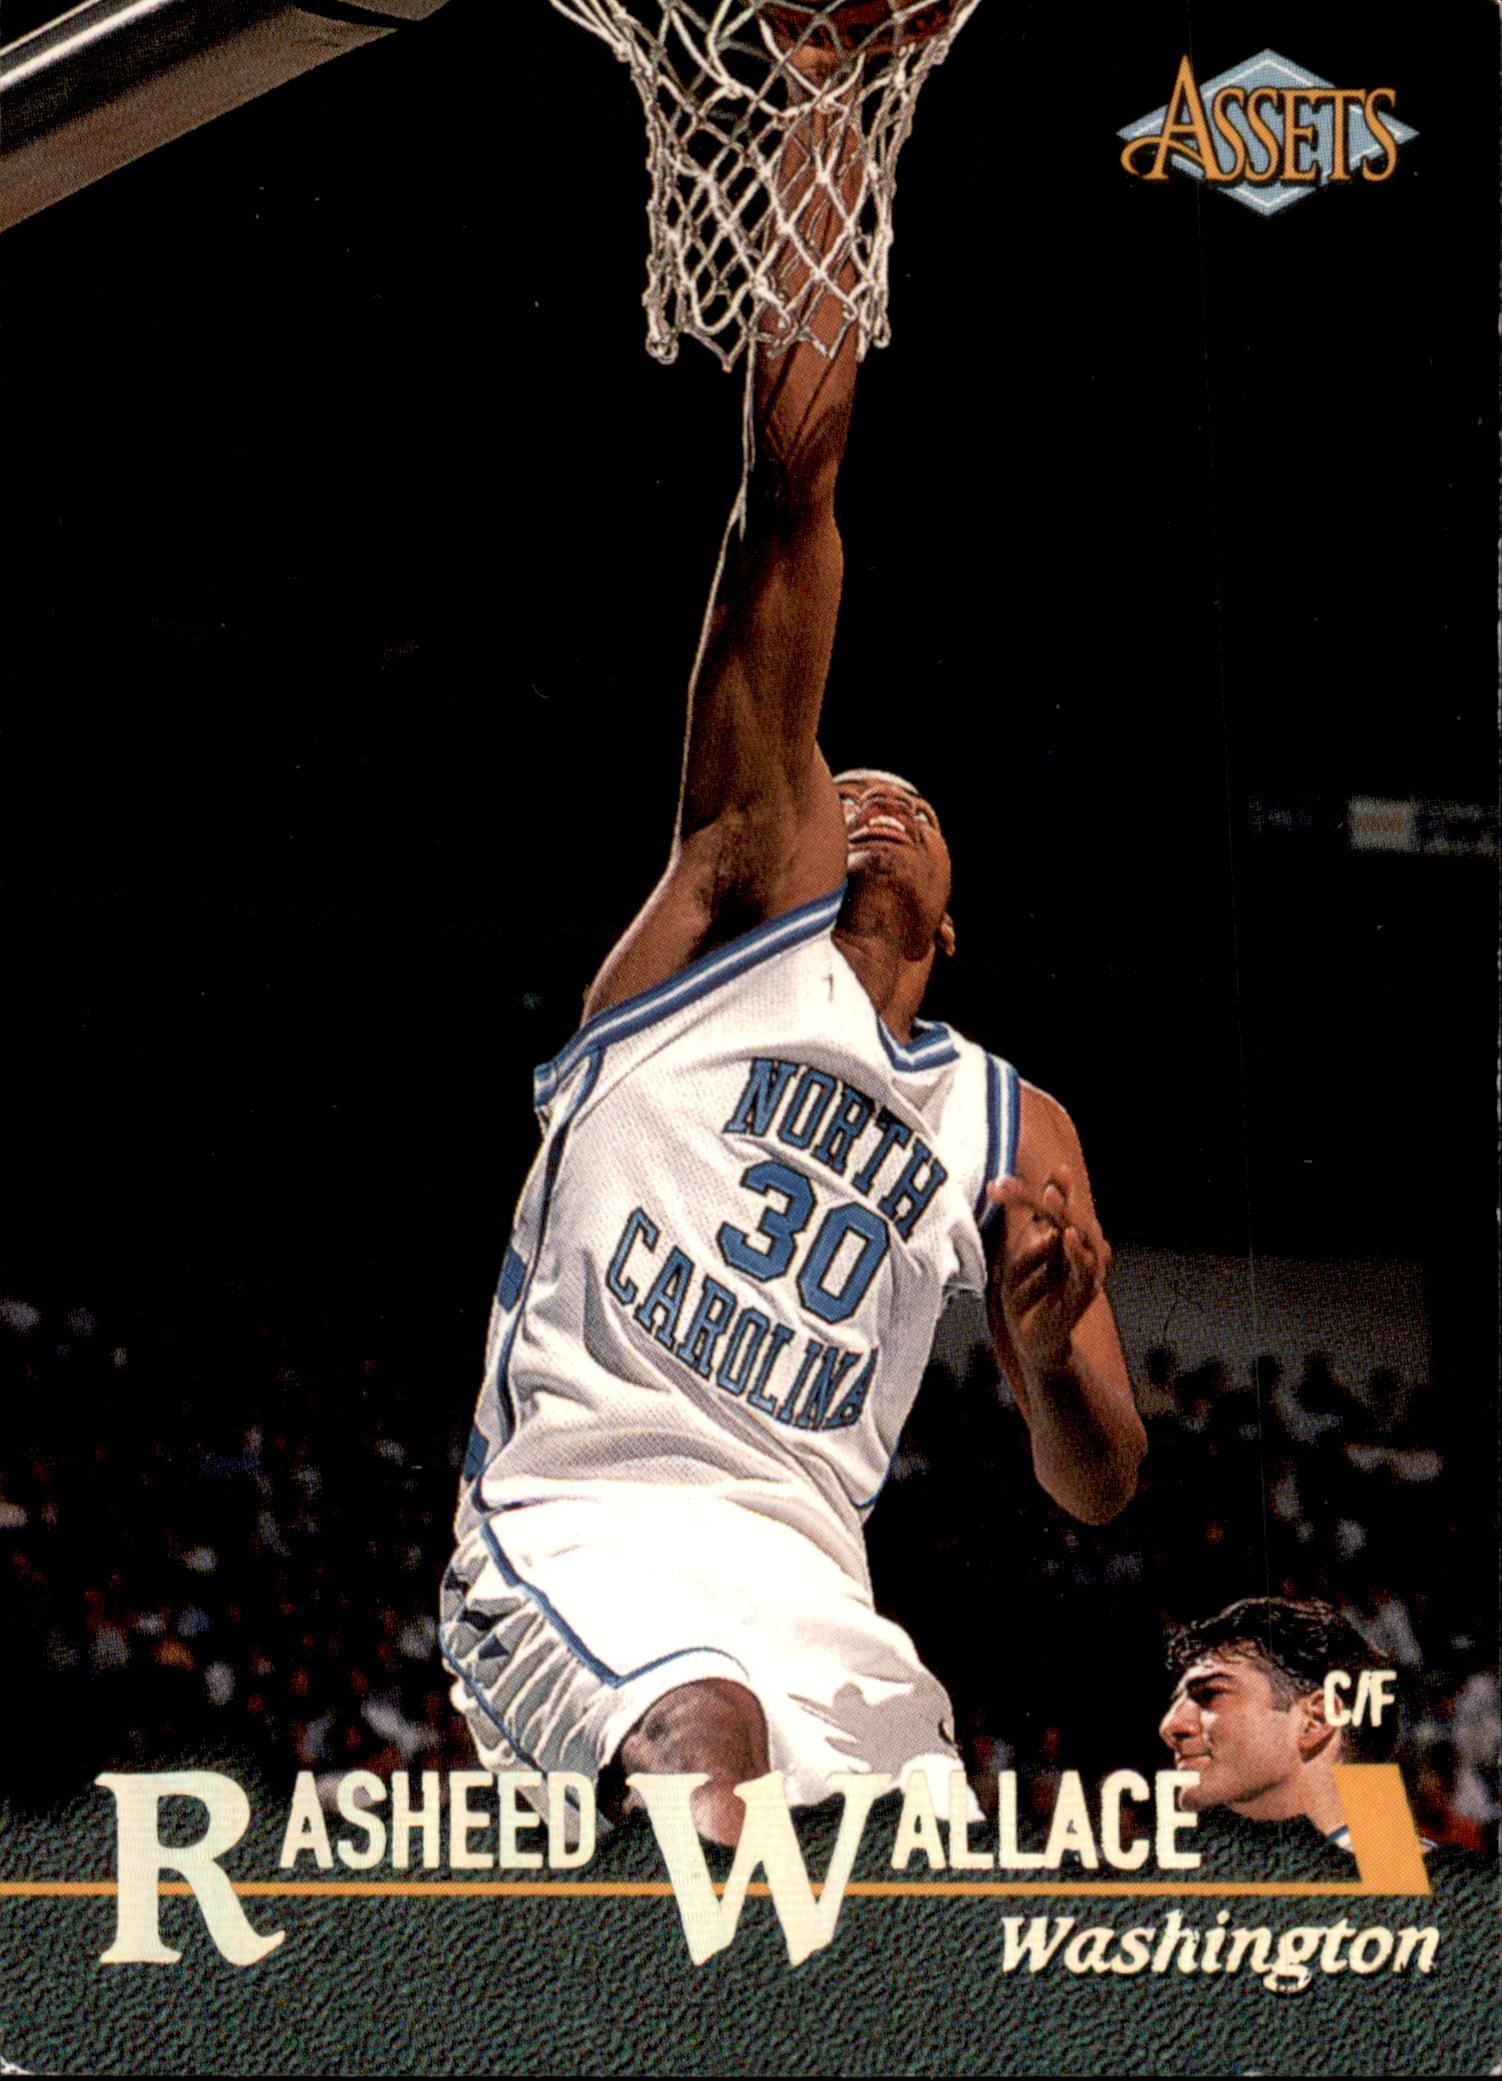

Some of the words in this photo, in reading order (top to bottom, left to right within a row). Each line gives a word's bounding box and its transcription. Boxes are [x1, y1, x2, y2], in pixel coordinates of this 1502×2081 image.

[716, 1159, 891, 1326] 30
[721, 1057, 949, 1243] NORTH
[605, 1206, 880, 1432] CAROLINA
